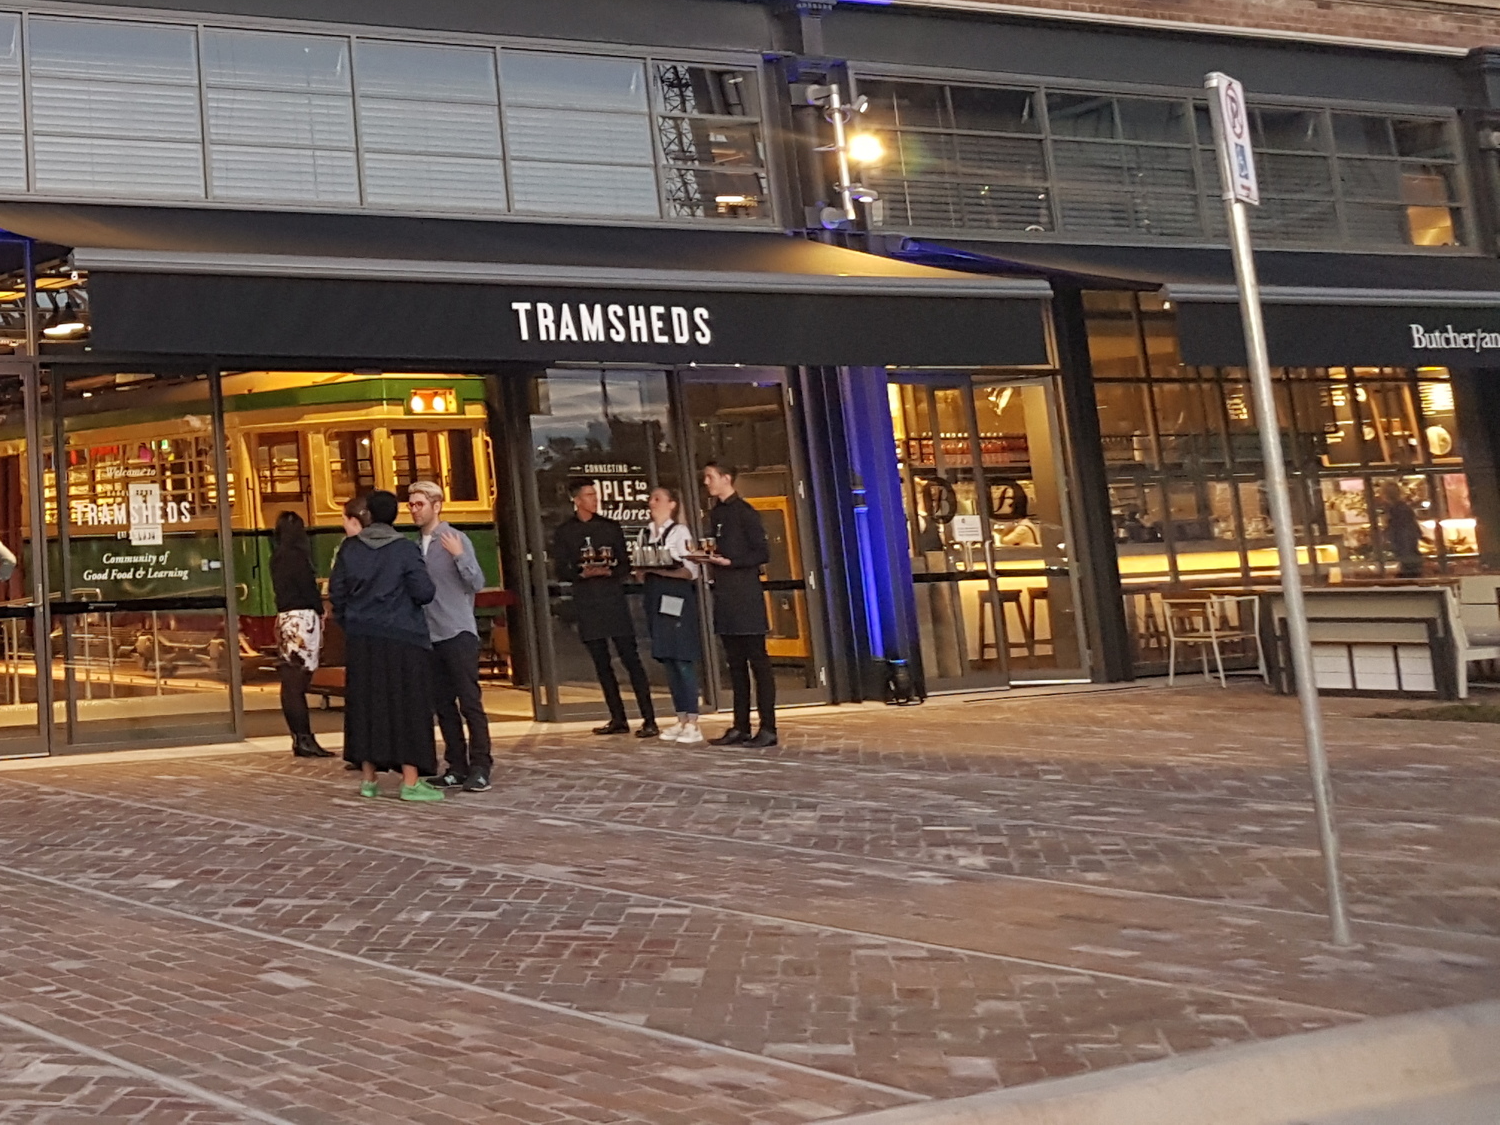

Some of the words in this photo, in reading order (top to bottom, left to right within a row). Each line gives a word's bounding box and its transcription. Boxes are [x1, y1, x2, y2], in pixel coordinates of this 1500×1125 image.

[511, 302, 712, 344] TRAMSHEDS
[106, 466, 146, 477] Welcome
[147, 469, 157, 477] to
[584, 464, 628, 473] CONNECTING
[634, 479, 647, 490] to
[76, 502, 191, 526] TRAMSHEDS
[102, 552, 158, 565] Community
[159, 551, 170, 565] of
[83, 569, 108, 581] Good
[110, 568, 133, 580] Food
[135, 568, 146, 579] &
[147, 567, 189, 580] Learning
